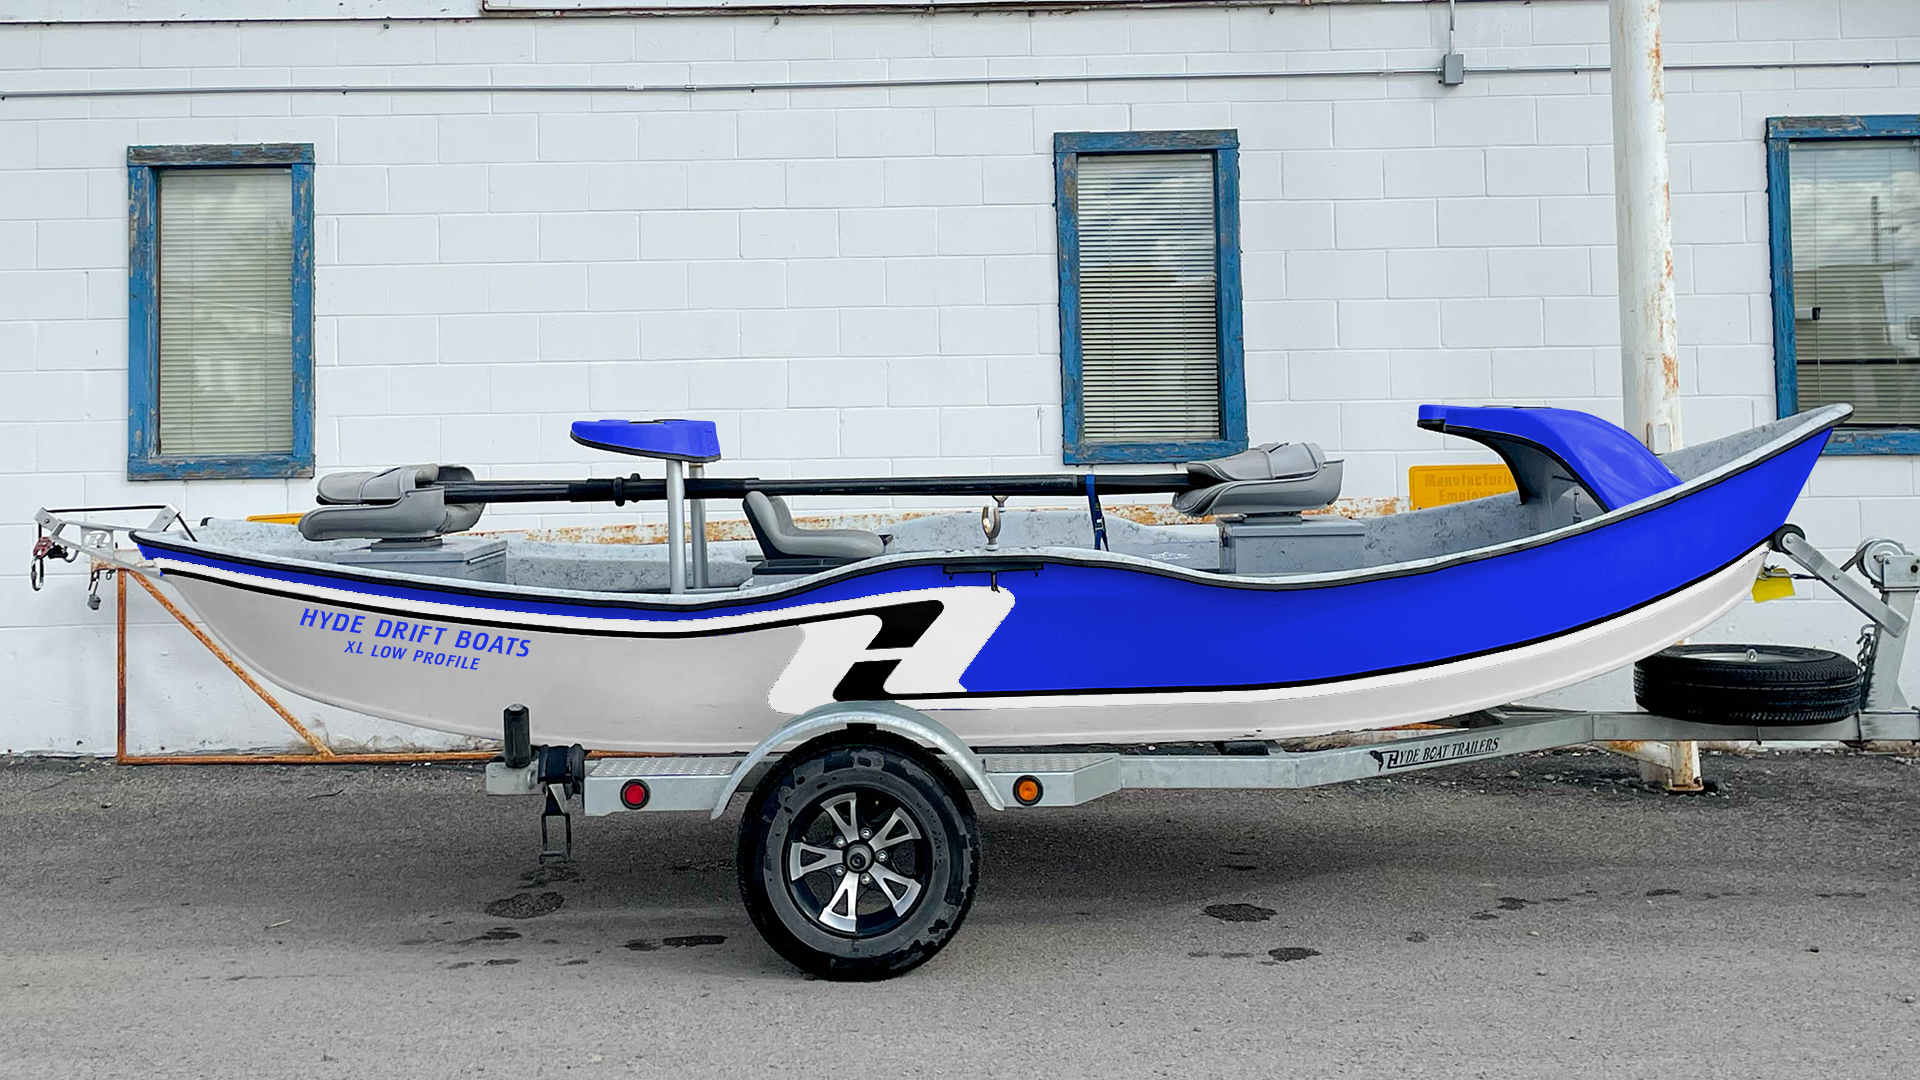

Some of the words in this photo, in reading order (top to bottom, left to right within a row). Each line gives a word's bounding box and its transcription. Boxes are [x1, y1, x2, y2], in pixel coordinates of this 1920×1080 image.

[1438, 489, 1511, 503] Emplo
[299, 607, 366, 634] HYDE
[374, 618, 449, 646] DRIFT
[454, 629, 532, 658] BOATS
[343, 640, 365, 655] XL
[370, 644, 408, 660] LOW
[412, 649, 481, 671] PROFILE
[1387, 749, 1420, 769] HYDE
[1423, 744, 1450, 761] BOAT
[1452, 737, 1500, 757] TRAILERS
